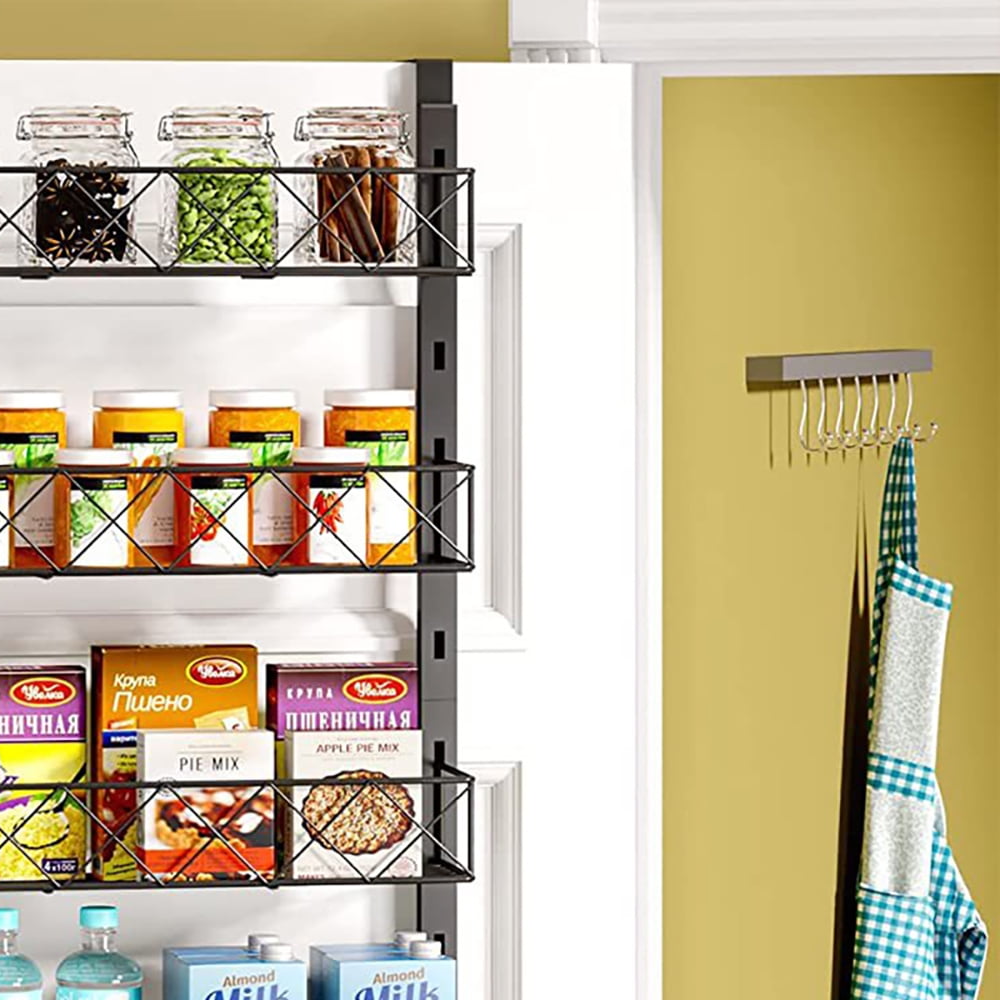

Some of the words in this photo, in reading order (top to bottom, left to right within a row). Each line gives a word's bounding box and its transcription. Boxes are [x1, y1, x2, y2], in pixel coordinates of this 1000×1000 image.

[113, 673, 156, 690] Крупа
[112, 691, 193, 712] Пшено
[286, 687, 333, 699] КРУПА
[285, 710, 412, 730] ПШЕНИЧНАЯ
[316, 743, 353, 753] APPLE
[356, 743, 375, 753] PIE
[378, 743, 400, 753] MIX
[179, 757, 203, 771] PIE
[212, 757, 240, 771] MIX
[223, 969, 275, 988] Almond
[373, 967, 425, 985] Almond
